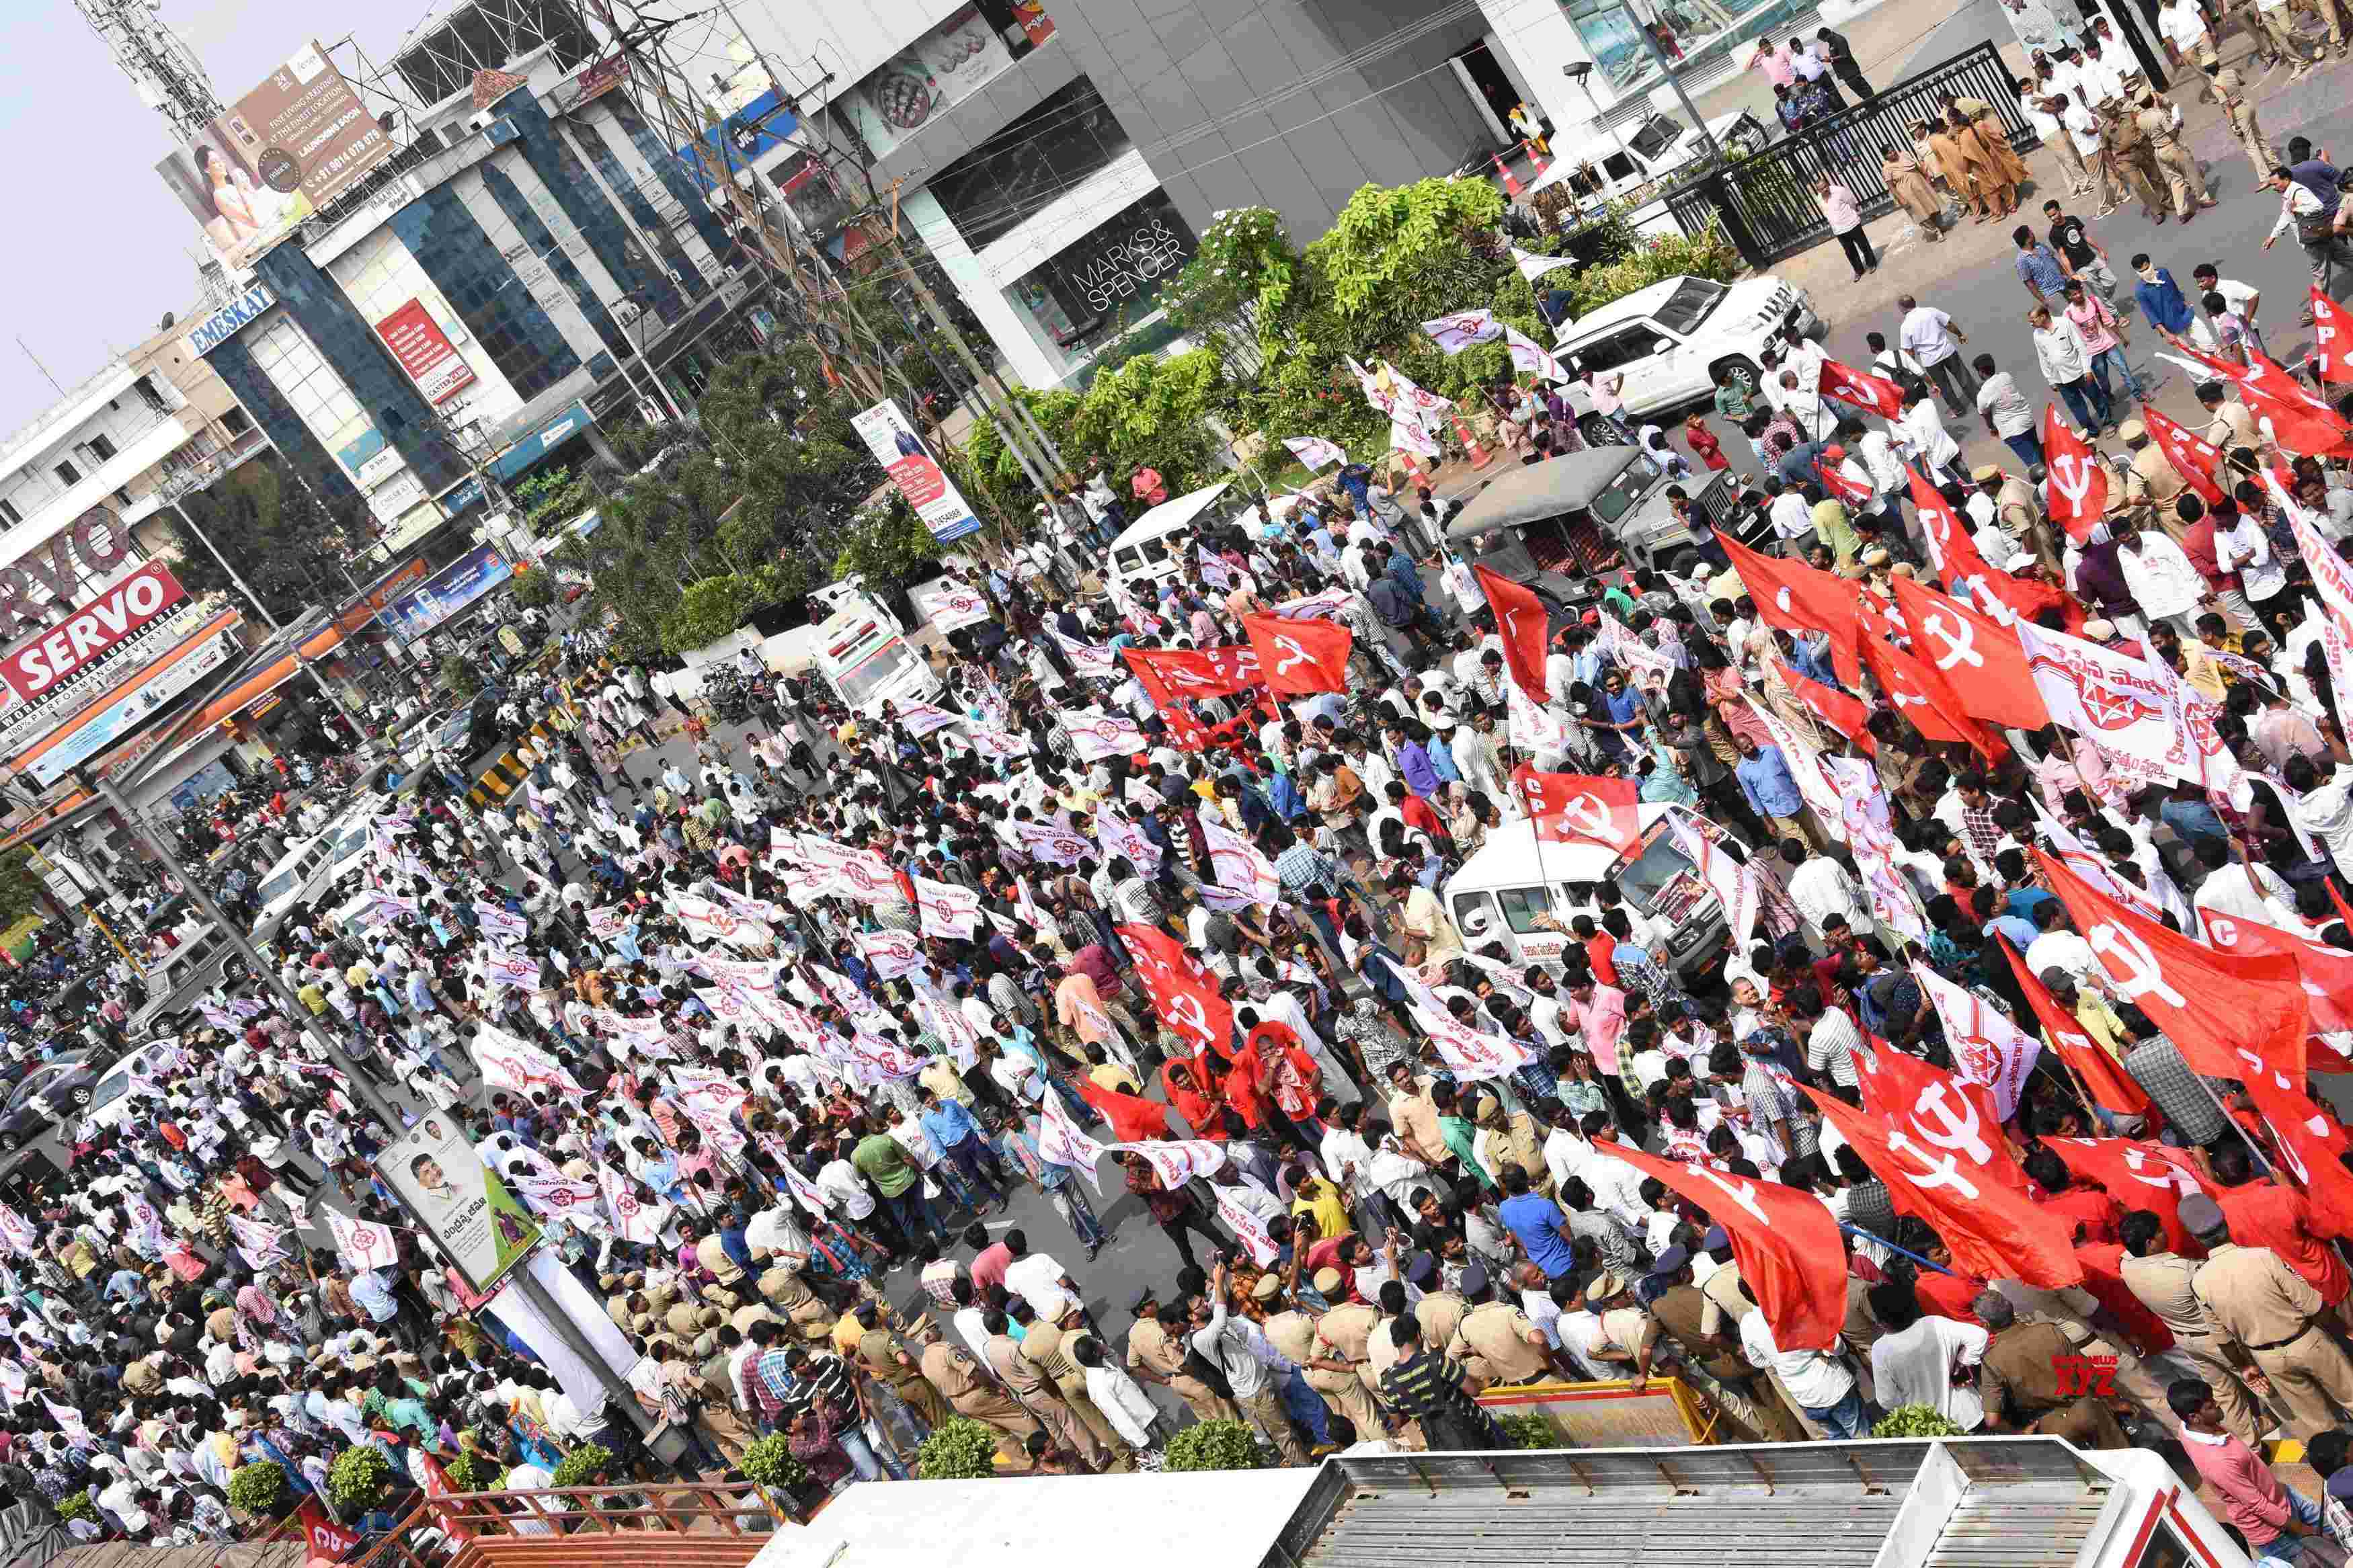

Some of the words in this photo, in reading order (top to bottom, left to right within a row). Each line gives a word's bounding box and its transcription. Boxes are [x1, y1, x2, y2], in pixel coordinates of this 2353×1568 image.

[1072, 226, 1158, 292] MARKS
[1148, 214, 1174, 243] &
[1085, 236, 1188, 314] SPENCER
[188, 284, 272, 355] EMESKAY
[1, 660, 97, 729] WORLD-CLASS
[99, 602, 182, 662] LUBRICANTS
[6, 718, 30, 737] 100%
[124, 607, 192, 659] EVERYTIME
[15, 574, 165, 691] SERVO
